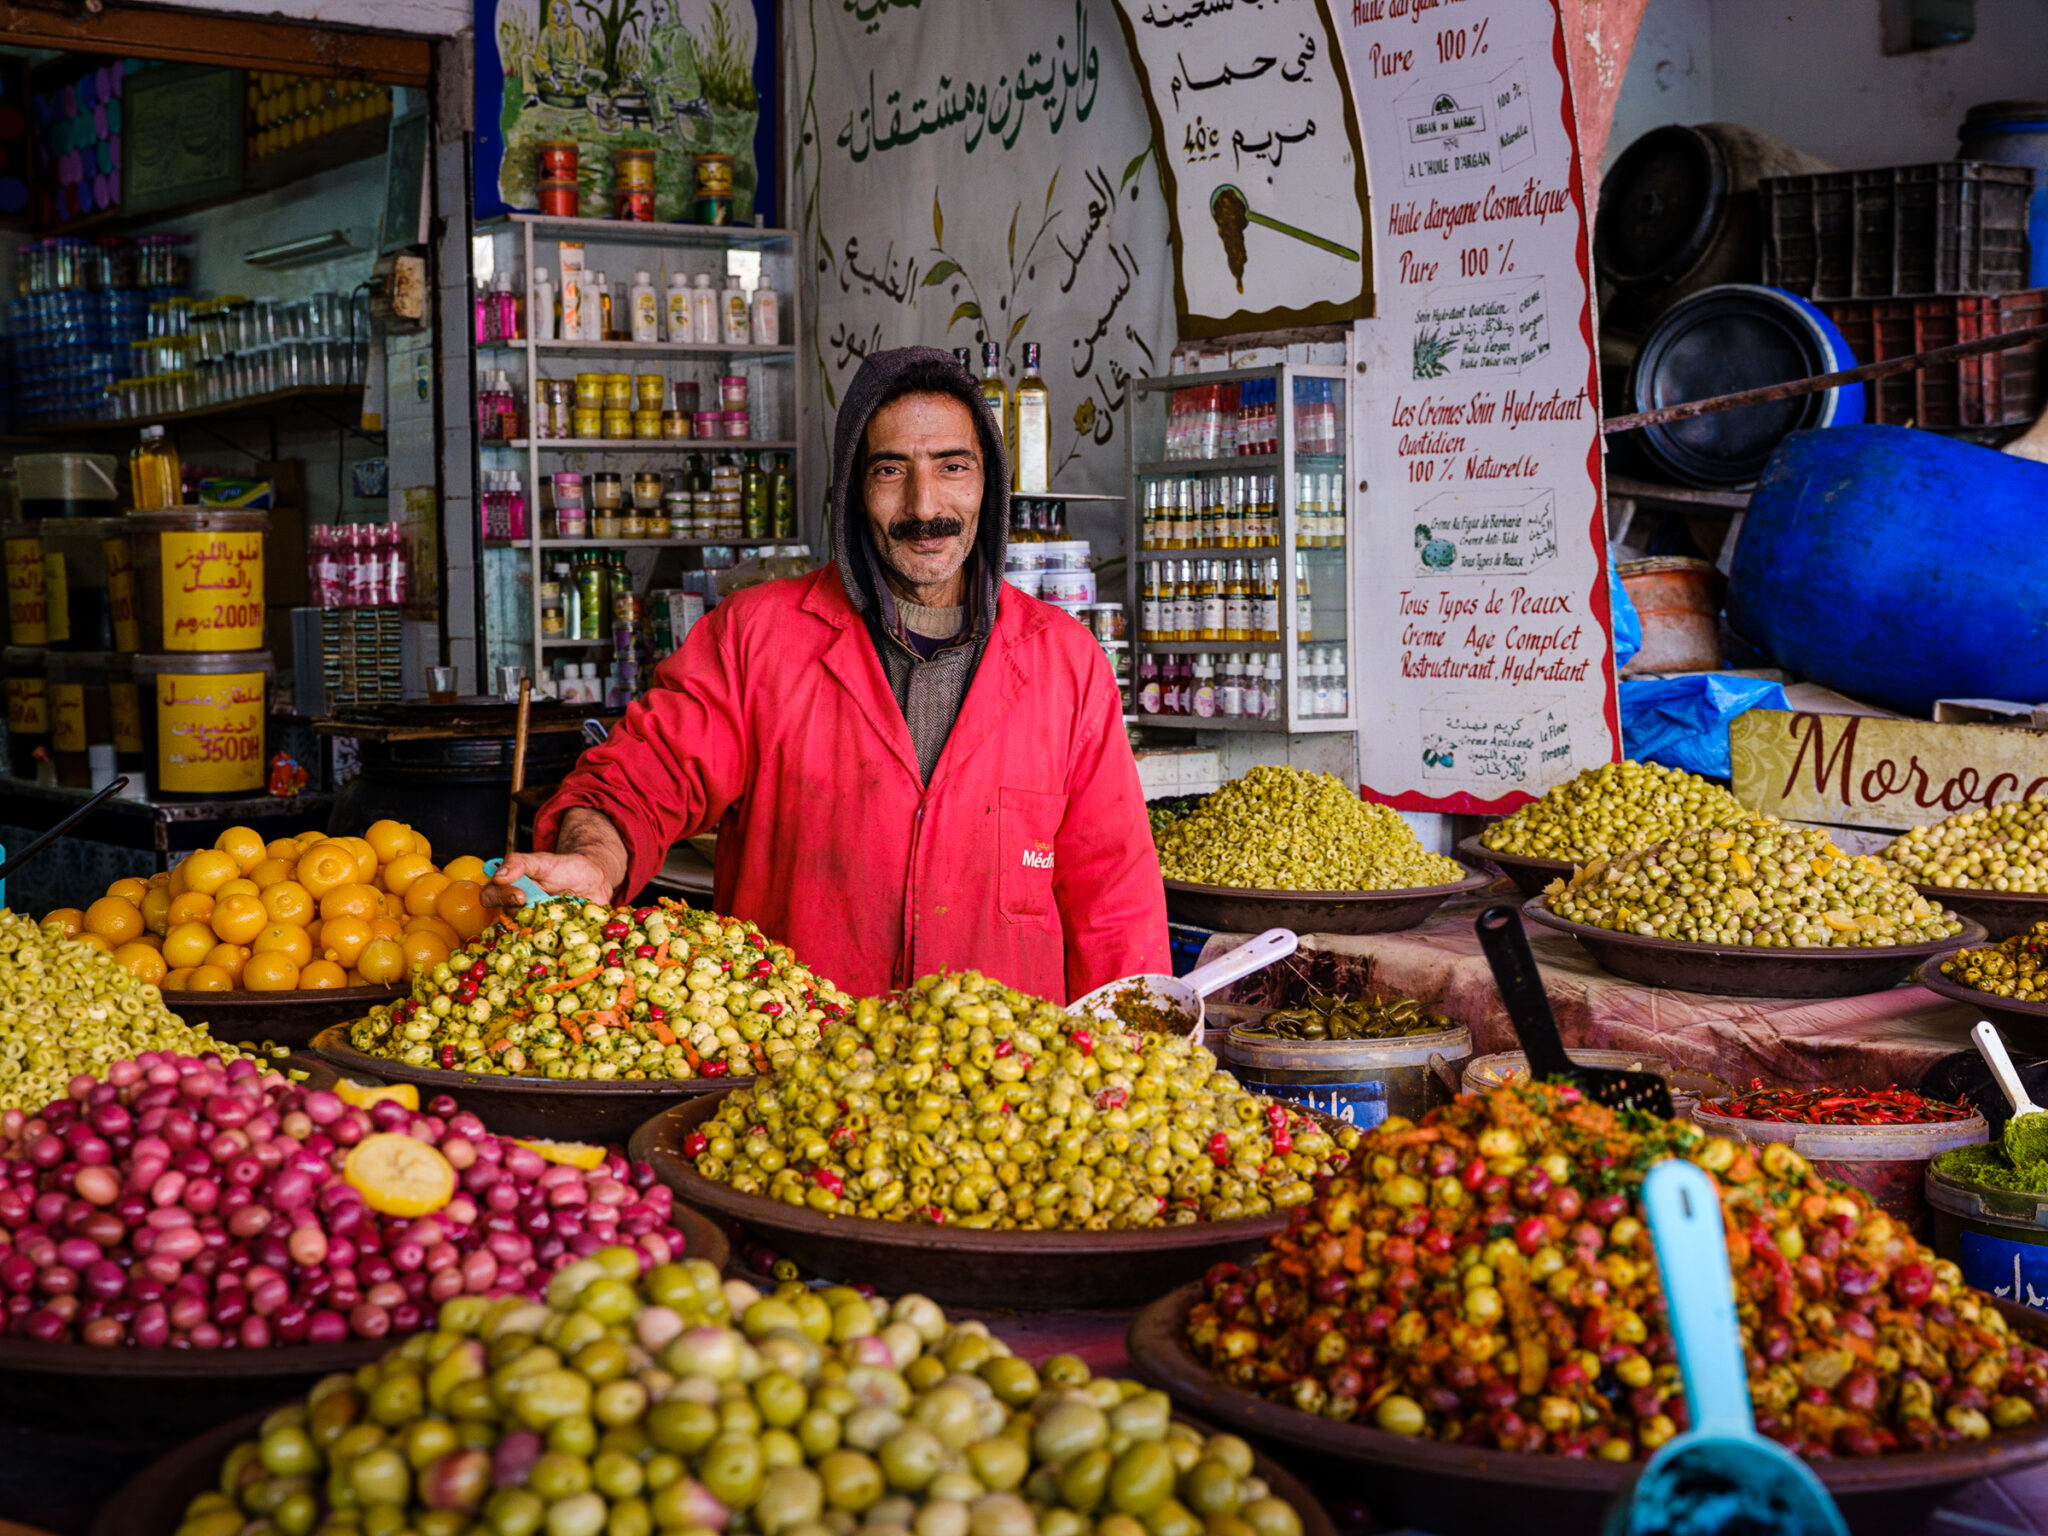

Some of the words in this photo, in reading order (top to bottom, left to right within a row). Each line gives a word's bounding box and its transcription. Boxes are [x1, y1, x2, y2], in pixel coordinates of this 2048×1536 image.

[1281, 32, 1317, 83] في
[1369, 42, 1415, 79] Pure
[1171, 52, 1278, 113] حمام
[1232, 119, 1317, 174] مريم
[1388, 200, 1422, 237] Huile
[1399, 249, 1438, 285] Pure
[1391, 395, 1416, 427] Les
[1466, 391, 1497, 425] Soin
[1501, 387, 1588, 431] Hydratant
[1398, 431, 1466, 458] Quotidien
[1465, 453, 1539, 480] Naturelle
[1400, 590, 1429, 616] Tous
[1438, 591, 1479, 624] Types
[1485, 588, 1504, 615] de
[1510, 586, 1573, 616] Peaux
[1402, 622, 1446, 648] Creme
[1463, 624, 1496, 657] Age
[1505, 624, 1582, 657] Complet
[1502, 655, 1591, 687] Hydratant
